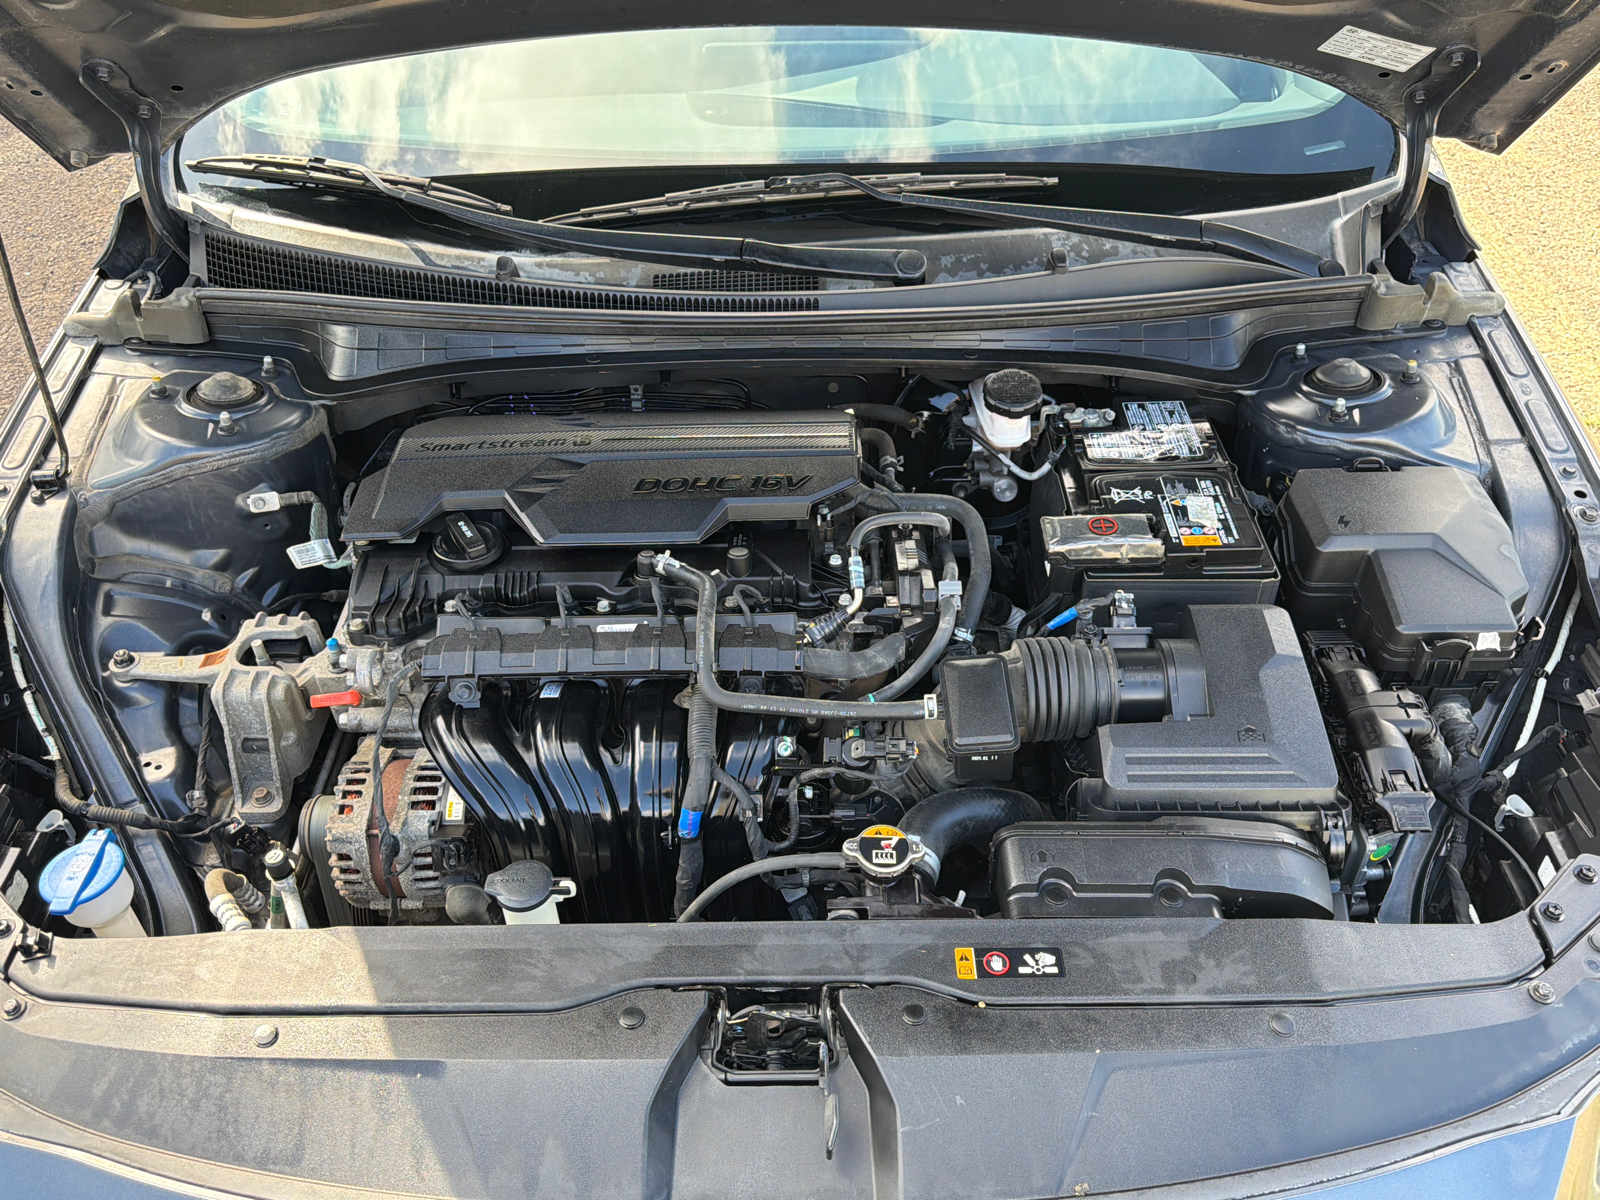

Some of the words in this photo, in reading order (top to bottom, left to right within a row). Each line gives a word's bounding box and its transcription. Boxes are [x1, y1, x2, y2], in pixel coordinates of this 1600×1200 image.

[419, 437, 567, 452] Smartstream
[632, 474, 744, 494] DOHC
[749, 473, 814, 491] 16V
